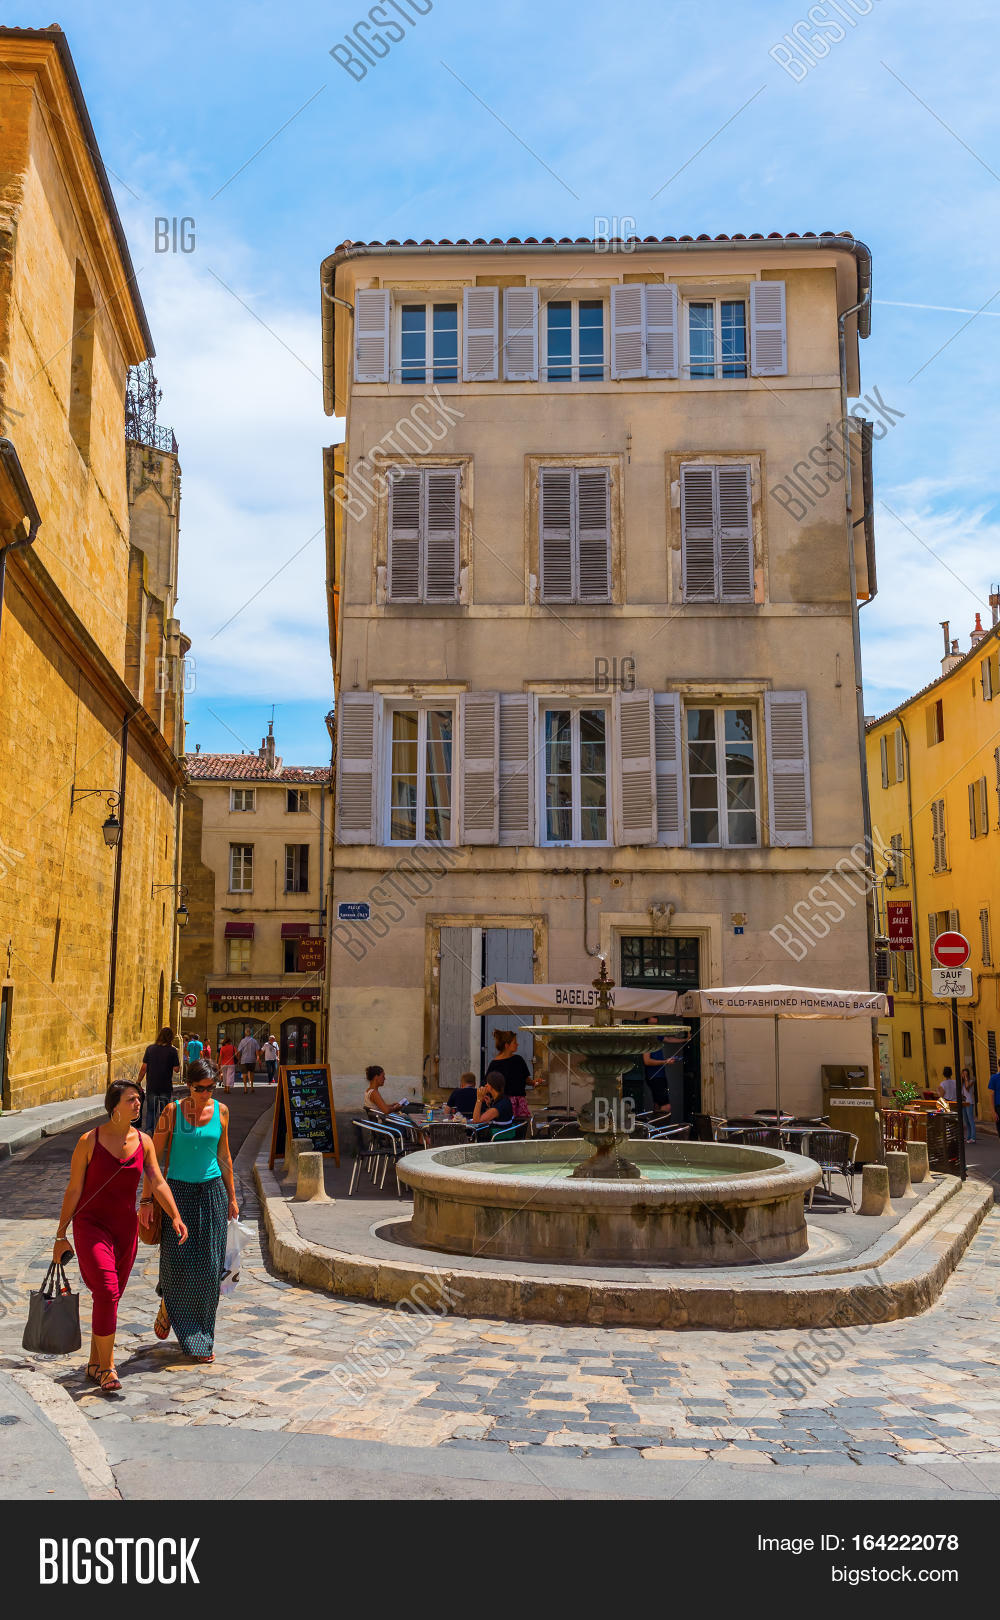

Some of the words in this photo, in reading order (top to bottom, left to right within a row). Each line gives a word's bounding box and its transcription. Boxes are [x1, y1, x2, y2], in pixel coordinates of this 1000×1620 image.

[896, 907, 904, 915] LA
[892, 917, 909, 925] SALLE
[940, 971, 963, 979] SAUF
[212, 1001, 283, 1014] BOUCHERIE
[707, 998, 724, 1006] THE
[727, 998, 798, 1007] OLD-FASHIONED
[800, 999, 850, 1009] HOMEMADE
[853, 1001, 882, 1010] BAGEL
